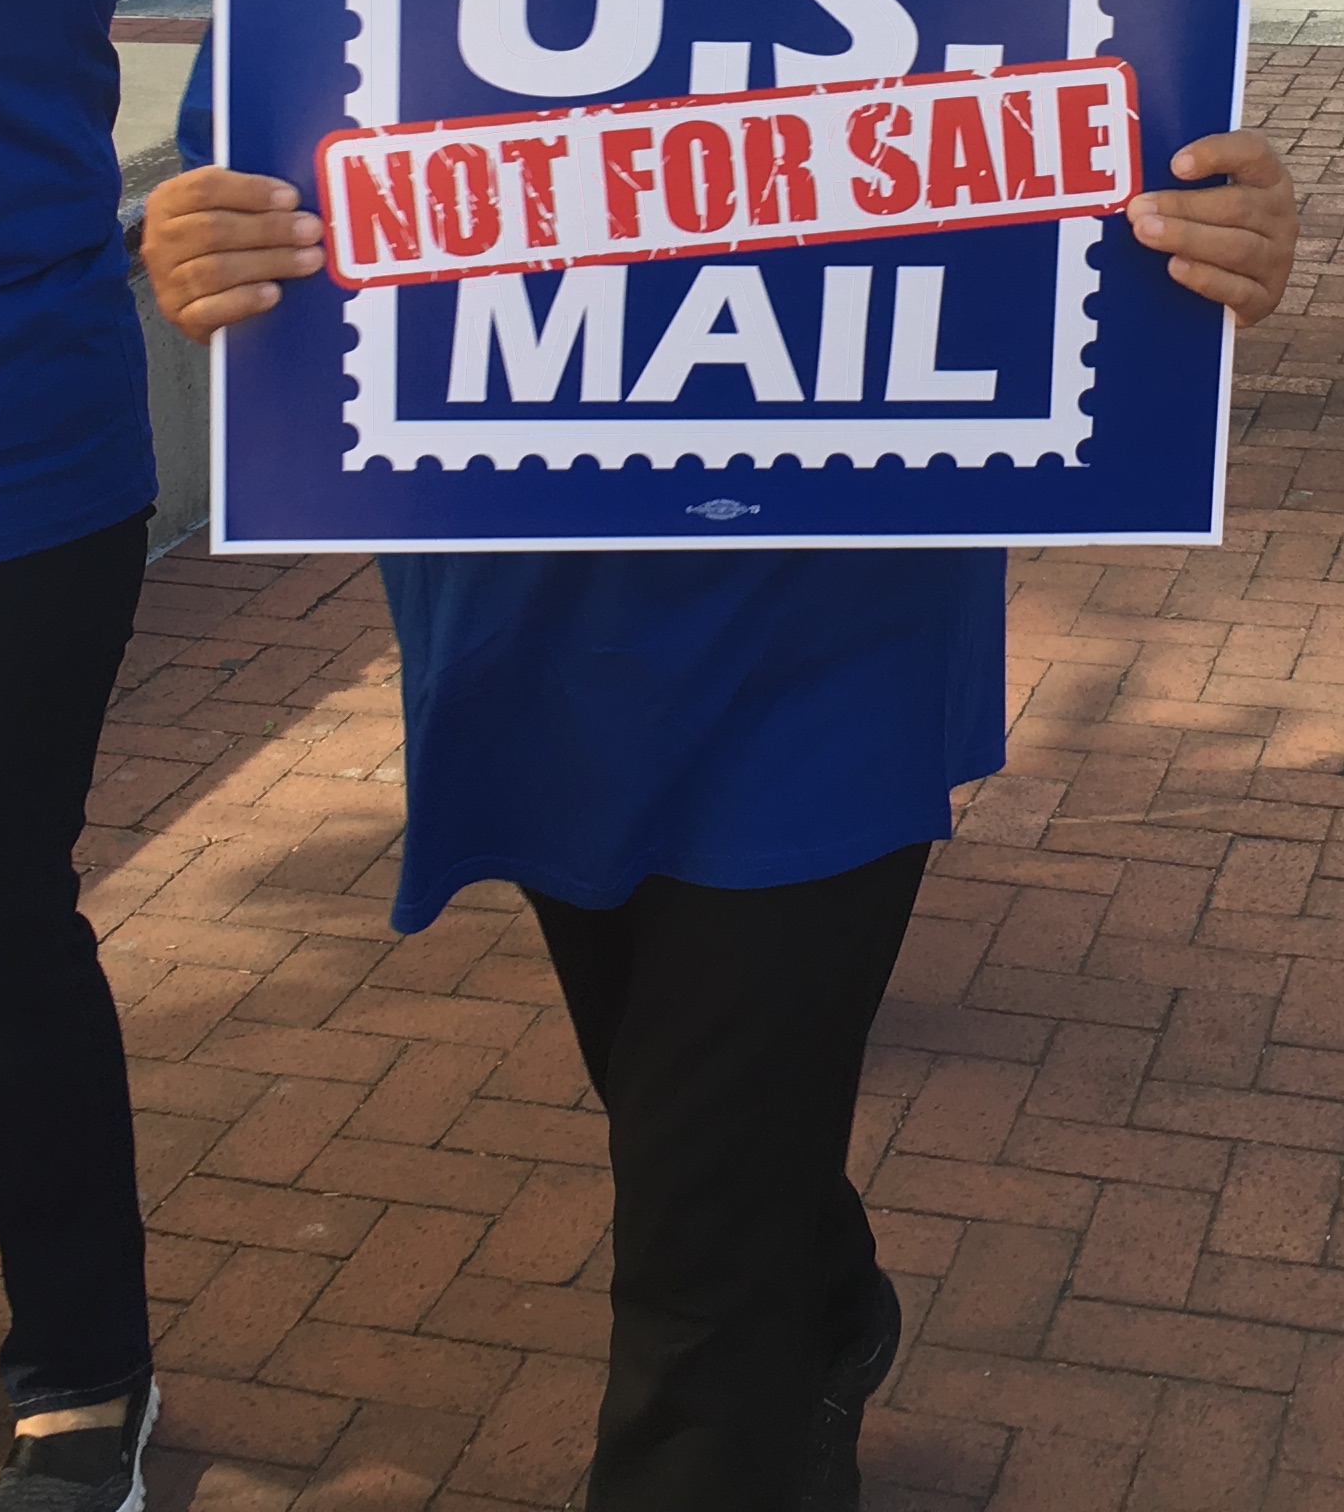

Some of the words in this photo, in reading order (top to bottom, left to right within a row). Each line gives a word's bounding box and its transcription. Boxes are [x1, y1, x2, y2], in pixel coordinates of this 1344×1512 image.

[342, 136, 571, 266] NOT
[595, 116, 818, 240] FOR
[849, 85, 1116, 217] SALE
[445, 265, 1000, 403] MAIL
